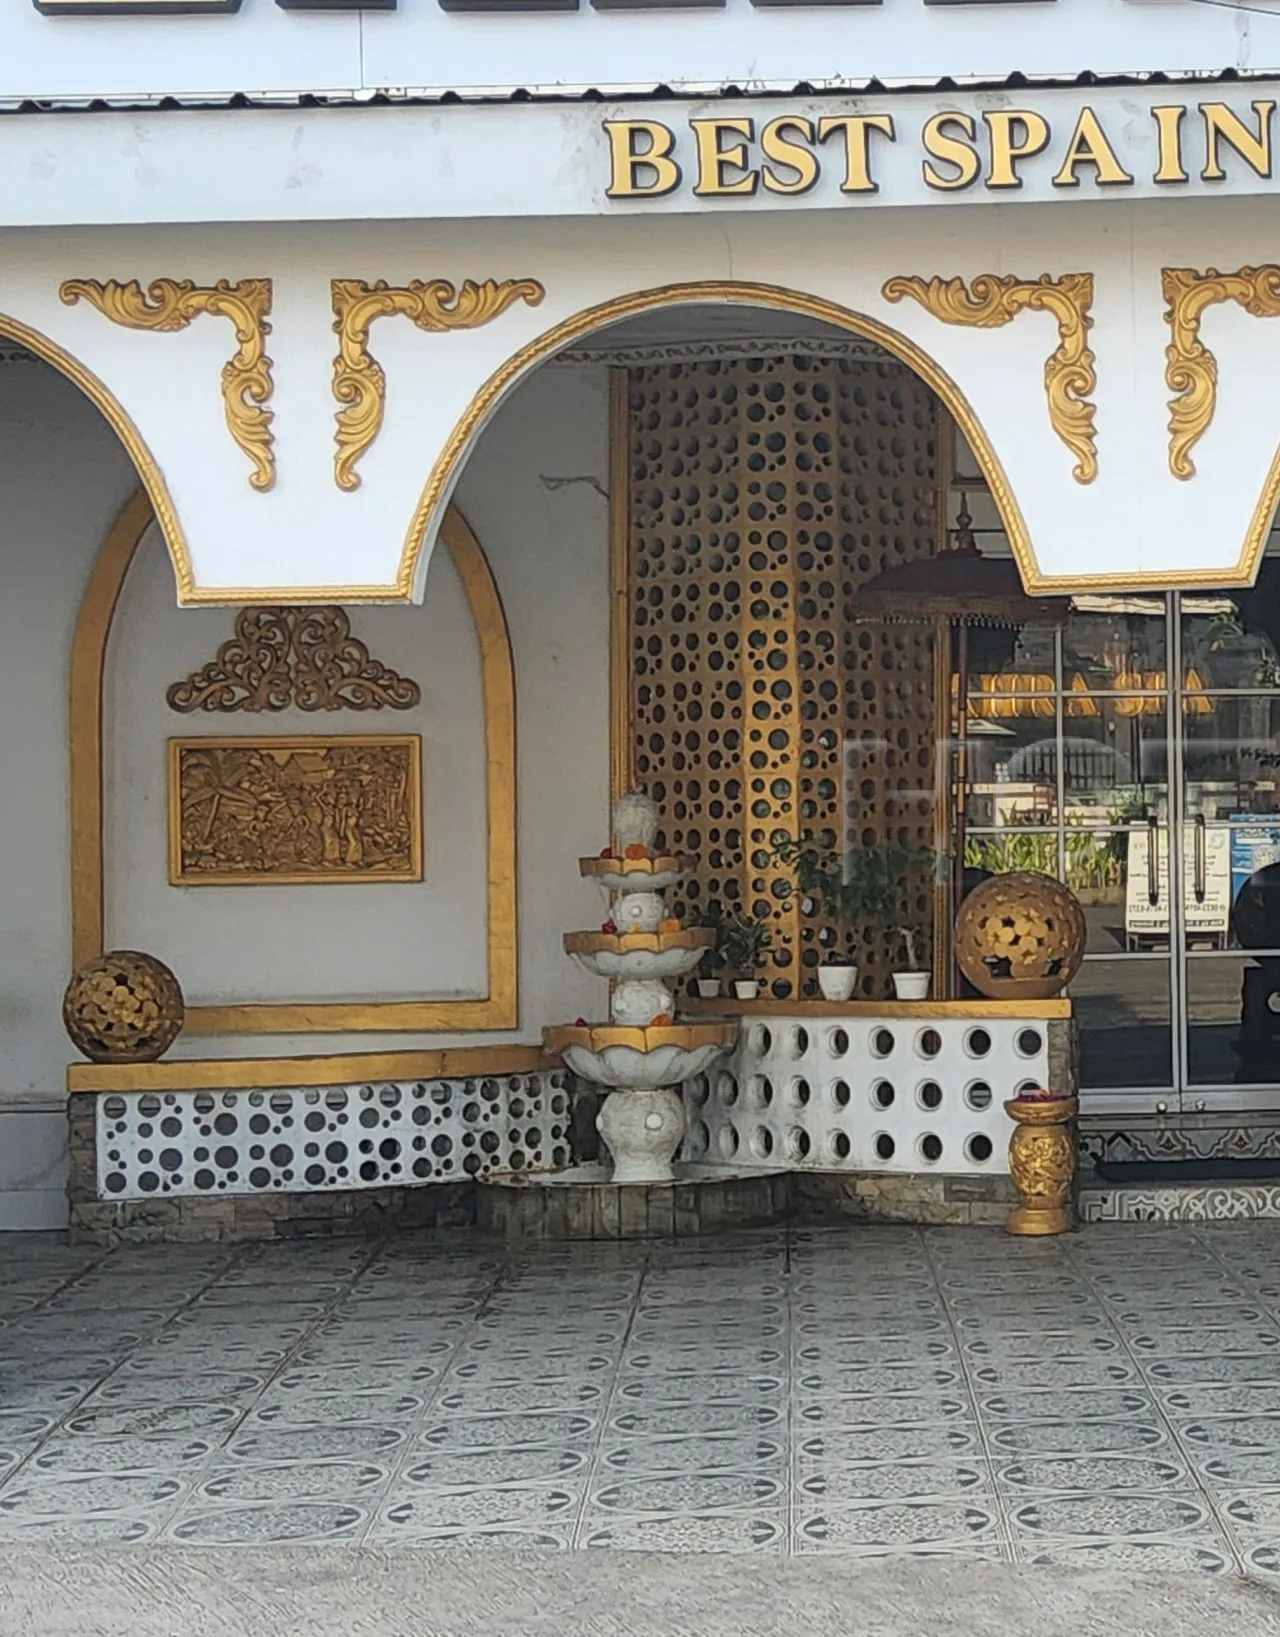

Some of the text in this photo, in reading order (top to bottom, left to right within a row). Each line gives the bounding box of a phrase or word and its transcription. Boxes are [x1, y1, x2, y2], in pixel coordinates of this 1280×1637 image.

[600, 113, 895, 199] BEST
[920, 108, 1133, 189] SPA
[1152, 100, 1274, 184] IN
